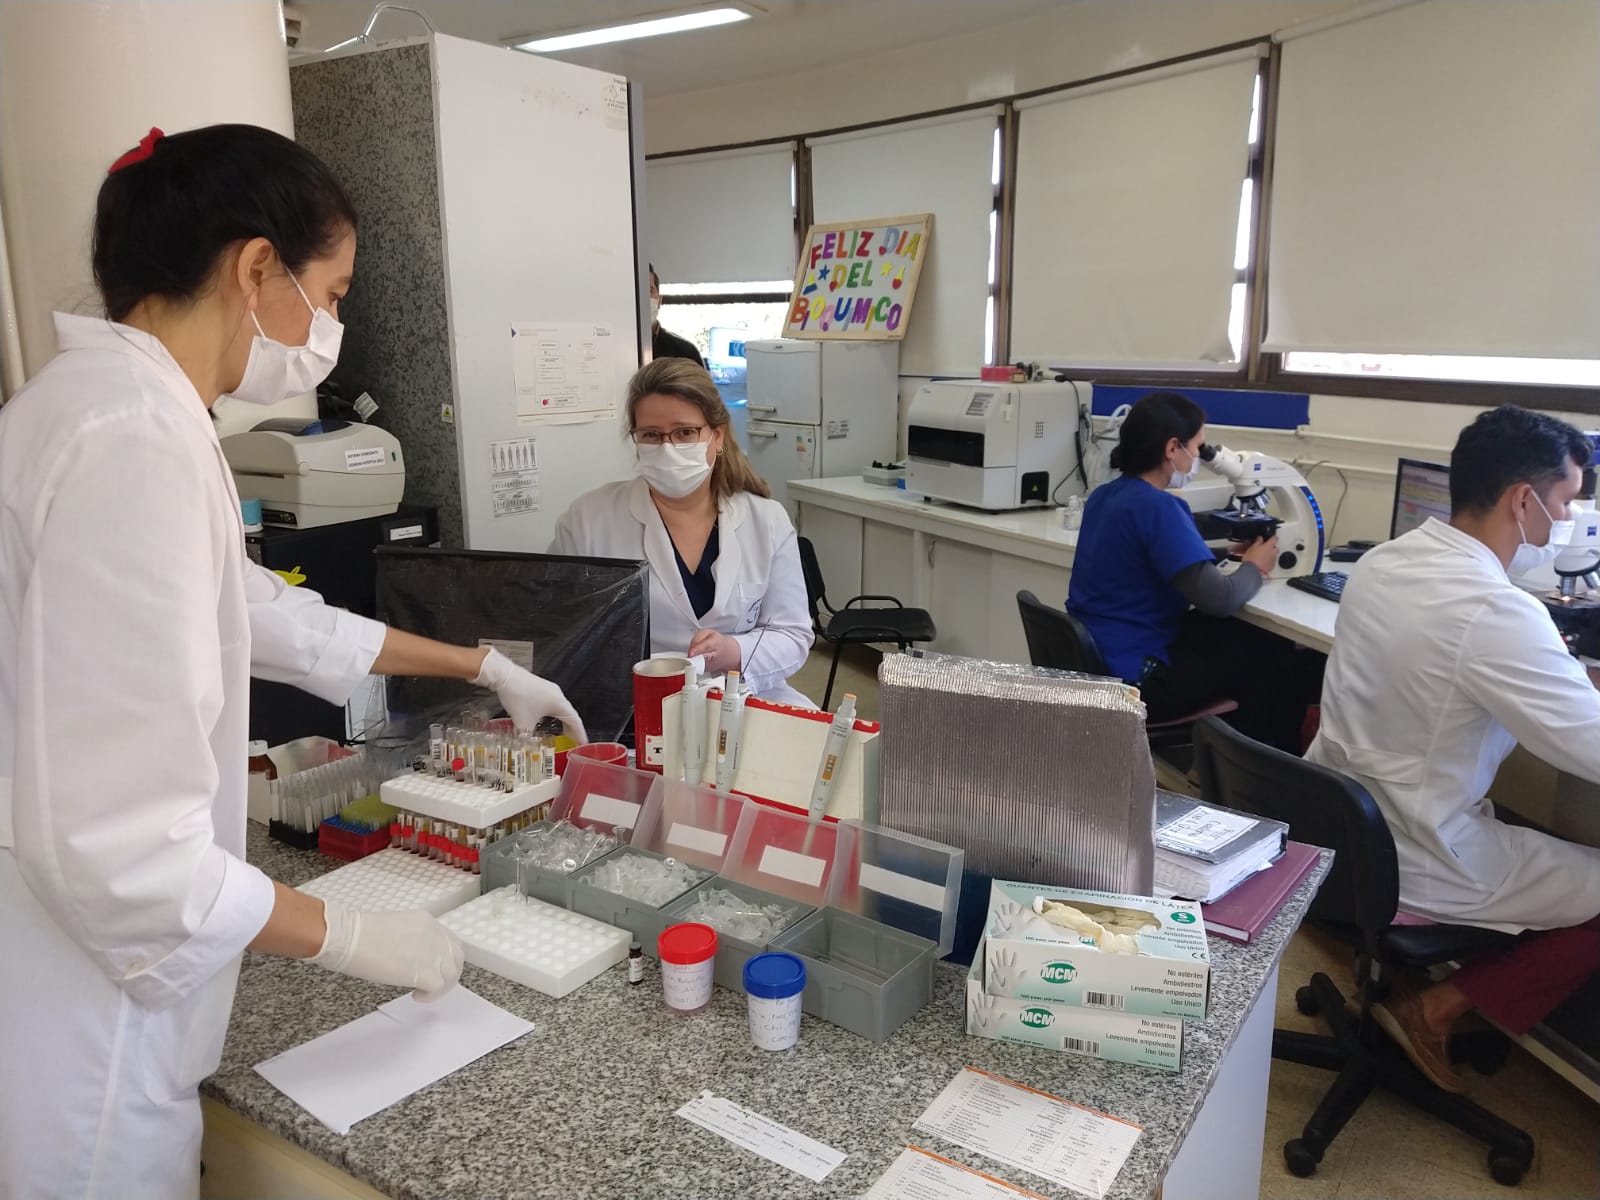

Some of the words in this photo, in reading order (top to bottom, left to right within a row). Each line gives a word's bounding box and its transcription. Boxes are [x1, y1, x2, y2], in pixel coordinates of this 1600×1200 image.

[810, 230, 874, 269] FELIZ
[883, 226, 921, 261] DIA
[832, 260, 873, 289] DEL
[1041, 967, 1077, 981] MCM
[1167, 969, 1176, 977] No
[1130, 985, 1165, 995] Levemente
[1020, 1011, 1055, 1026] MCM
